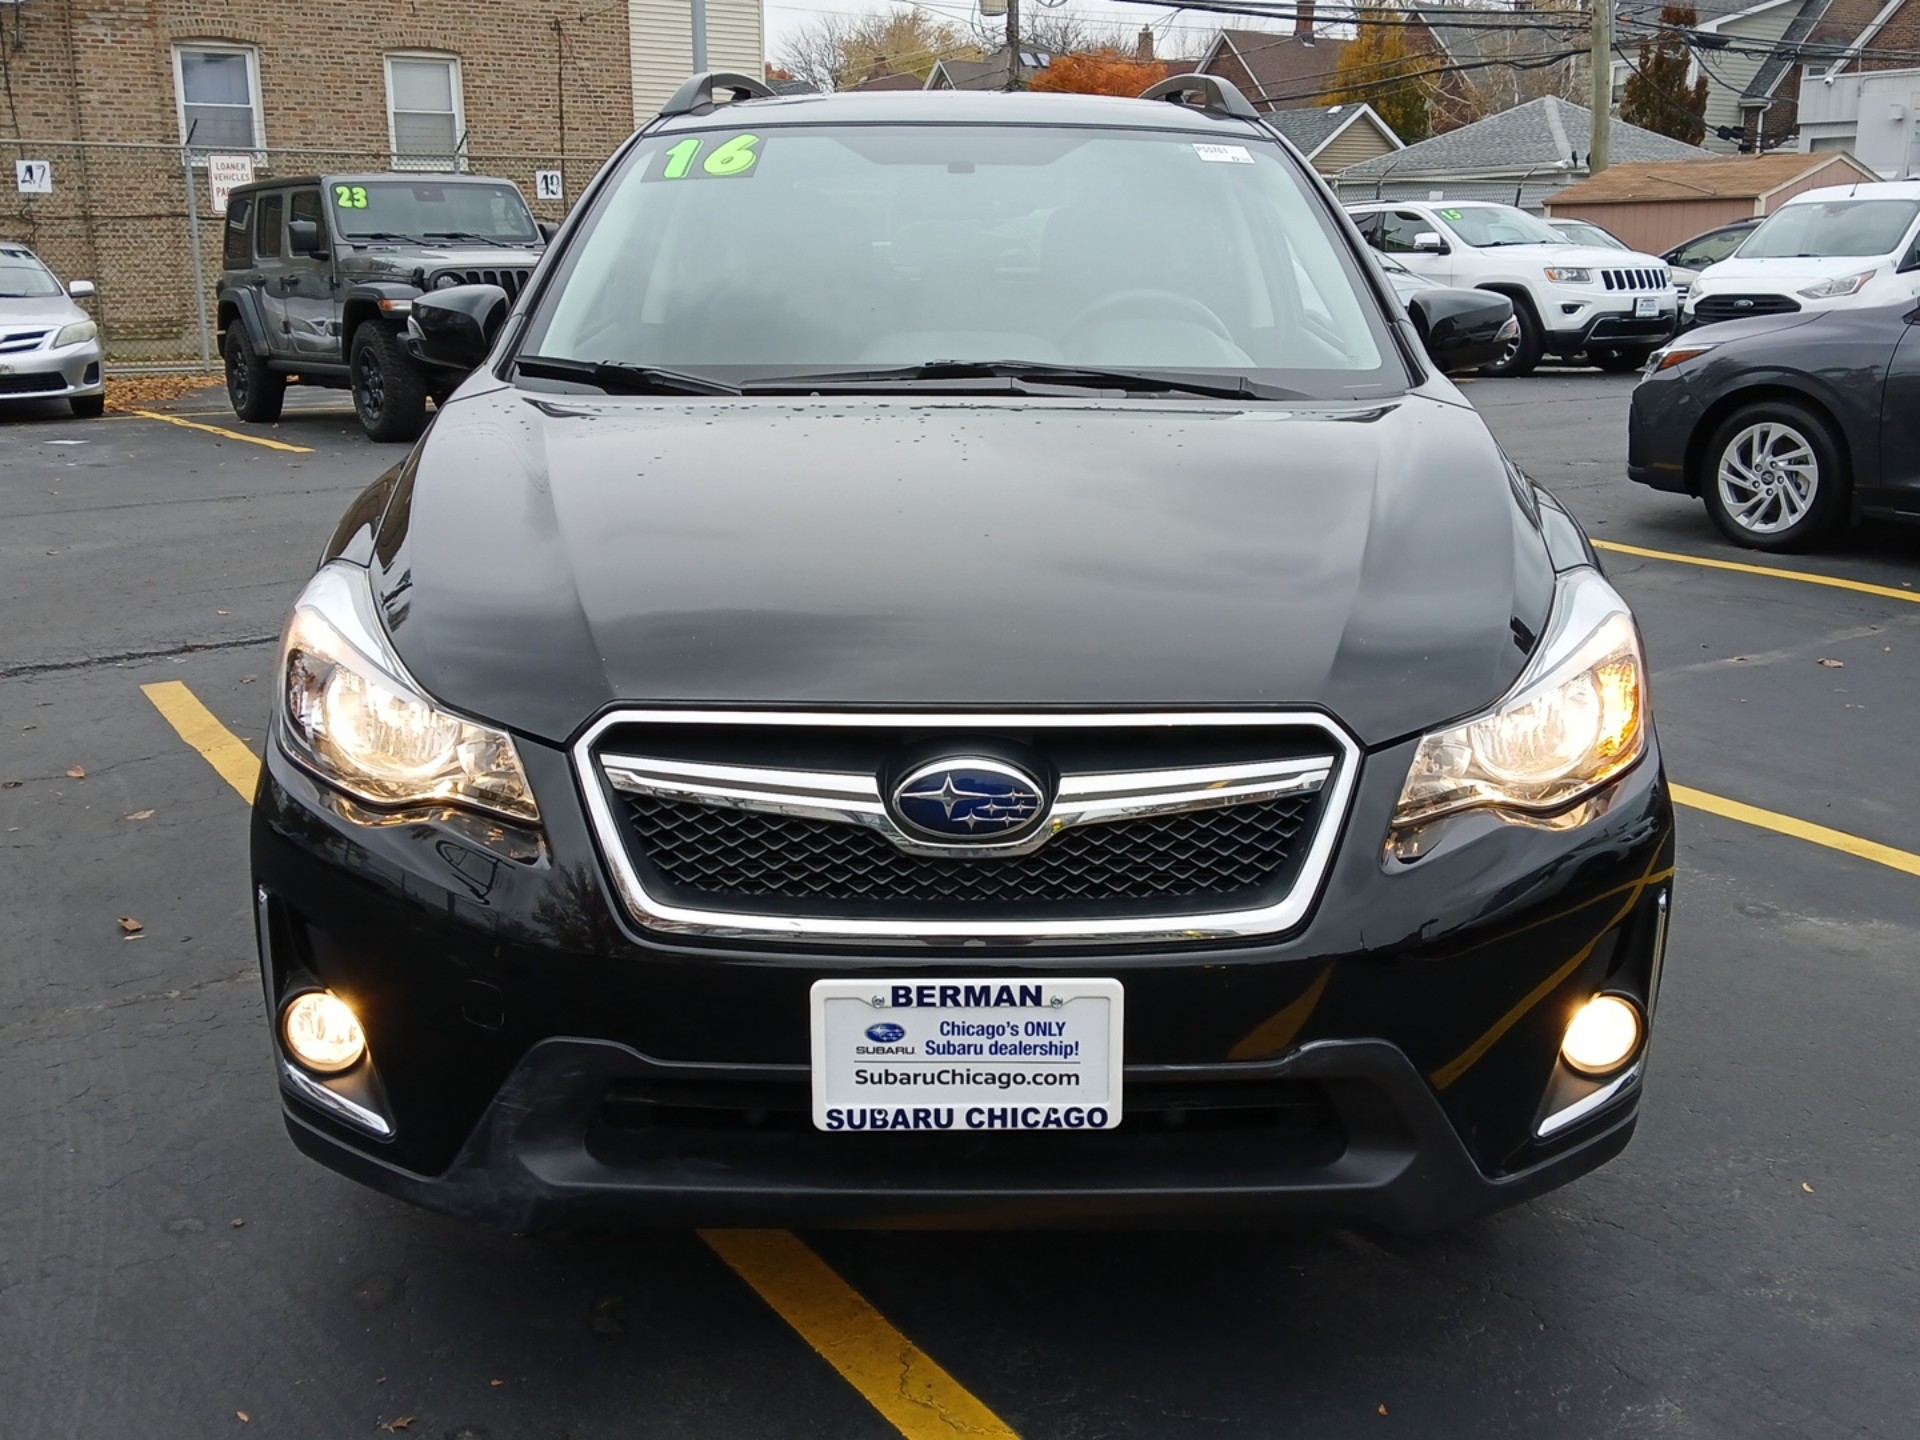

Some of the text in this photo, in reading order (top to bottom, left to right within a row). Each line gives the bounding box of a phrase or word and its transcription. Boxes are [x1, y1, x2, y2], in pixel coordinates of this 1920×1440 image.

[663, 133, 760, 178] 16
[215, 162, 246, 170] LOANER
[214, 173, 250, 181] VEHICLES
[334, 185, 368, 208] 23
[1440, 209, 1463, 220] 15
[891, 985, 1042, 1007] BERMAN
[940, 1021, 1066, 1040] Chicago's ONLY
[856, 1046, 916, 1055] SUBARU
[925, 1040, 1079, 1059] Subaru dealership!
[855, 1068, 1080, 1089] SubaruChicago.com
[826, 1107, 1108, 1129] SUBARU CHICAGO
